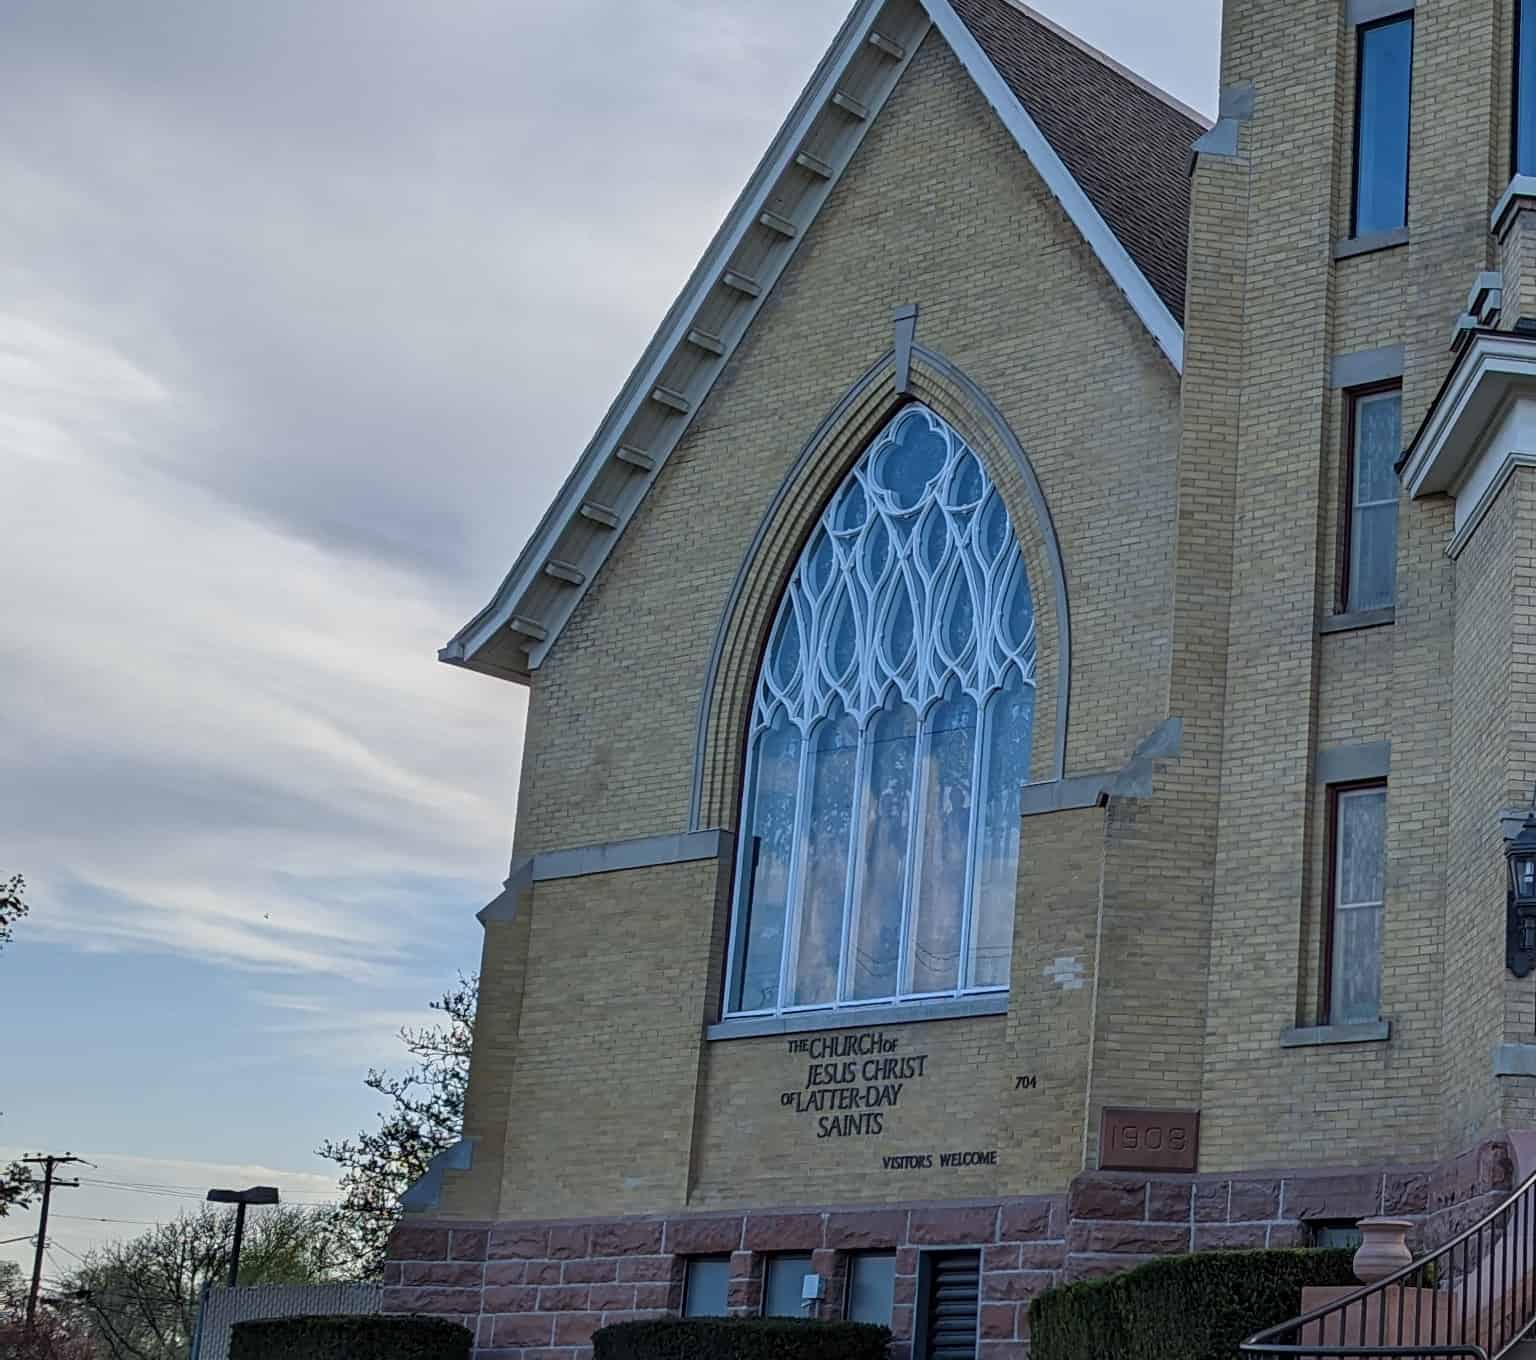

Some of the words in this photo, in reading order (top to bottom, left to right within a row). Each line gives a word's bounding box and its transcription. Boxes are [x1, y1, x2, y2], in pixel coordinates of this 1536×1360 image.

[788, 1039, 809, 1053] THE
[808, 1033, 883, 1059] CHURCH
[805, 1061, 857, 1089] JESUS
[862, 1055, 928, 1081] CHRIST
[1015, 1075, 1037, 1089] 704
[795, 1083, 903, 1112] LATTER-DAY
[817, 1112, 884, 1138] SAINTS
[1111, 1125, 1187, 1153] 1908
[882, 1154, 933, 1170] VISITORS
[939, 1150, 998, 1168] WELCOME
